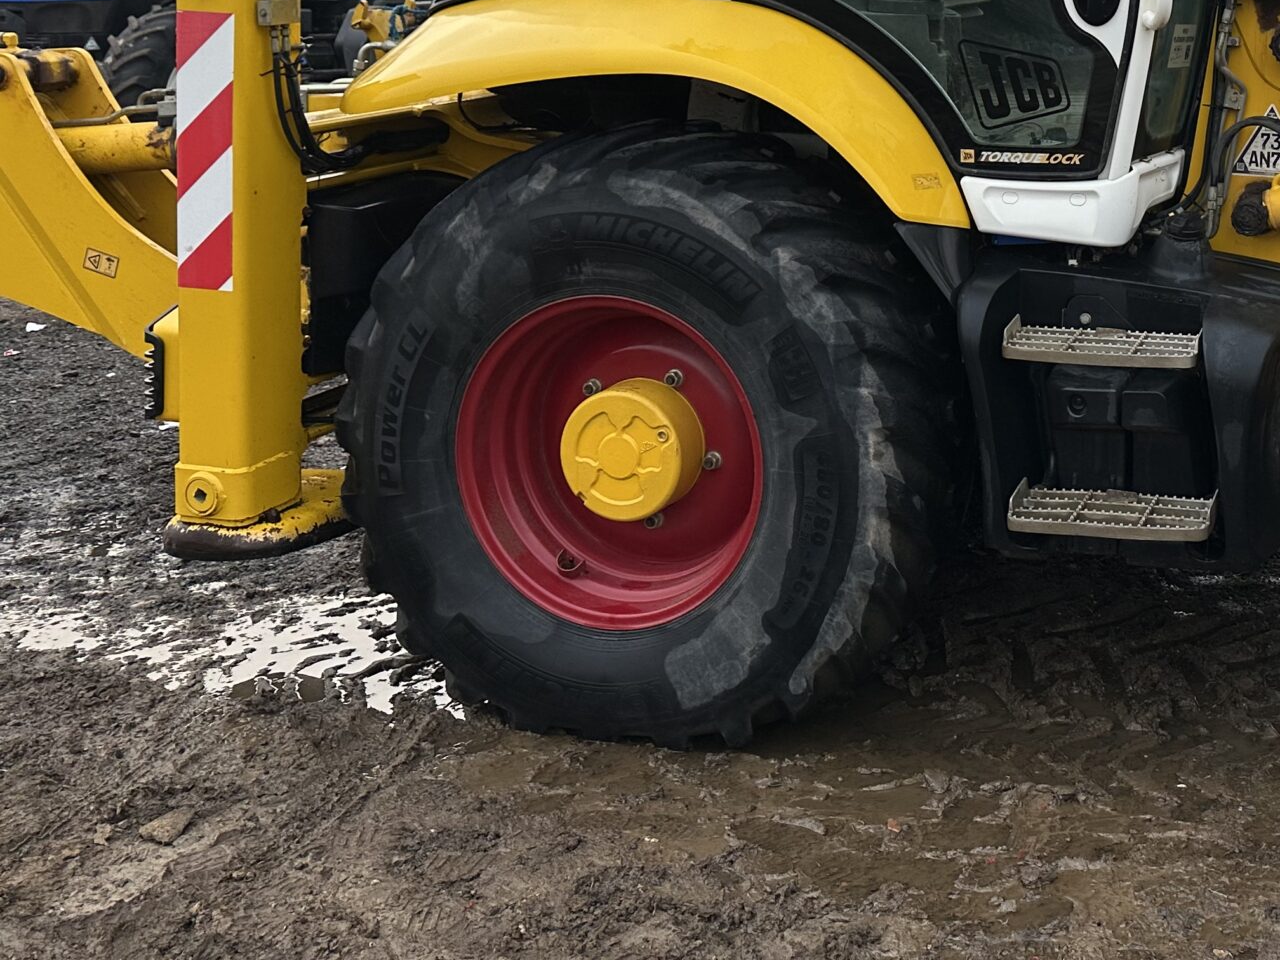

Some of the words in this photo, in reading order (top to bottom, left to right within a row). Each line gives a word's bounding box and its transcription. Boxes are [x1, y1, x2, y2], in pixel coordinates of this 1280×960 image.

[978, 50, 1064, 120] JCB
[980, 151, 1085, 165] TORQUELOCK
[1261, 132, 1280, 151] 73
[577, 214, 763, 302] MICHELIN
[397, 321, 428, 362] CL
